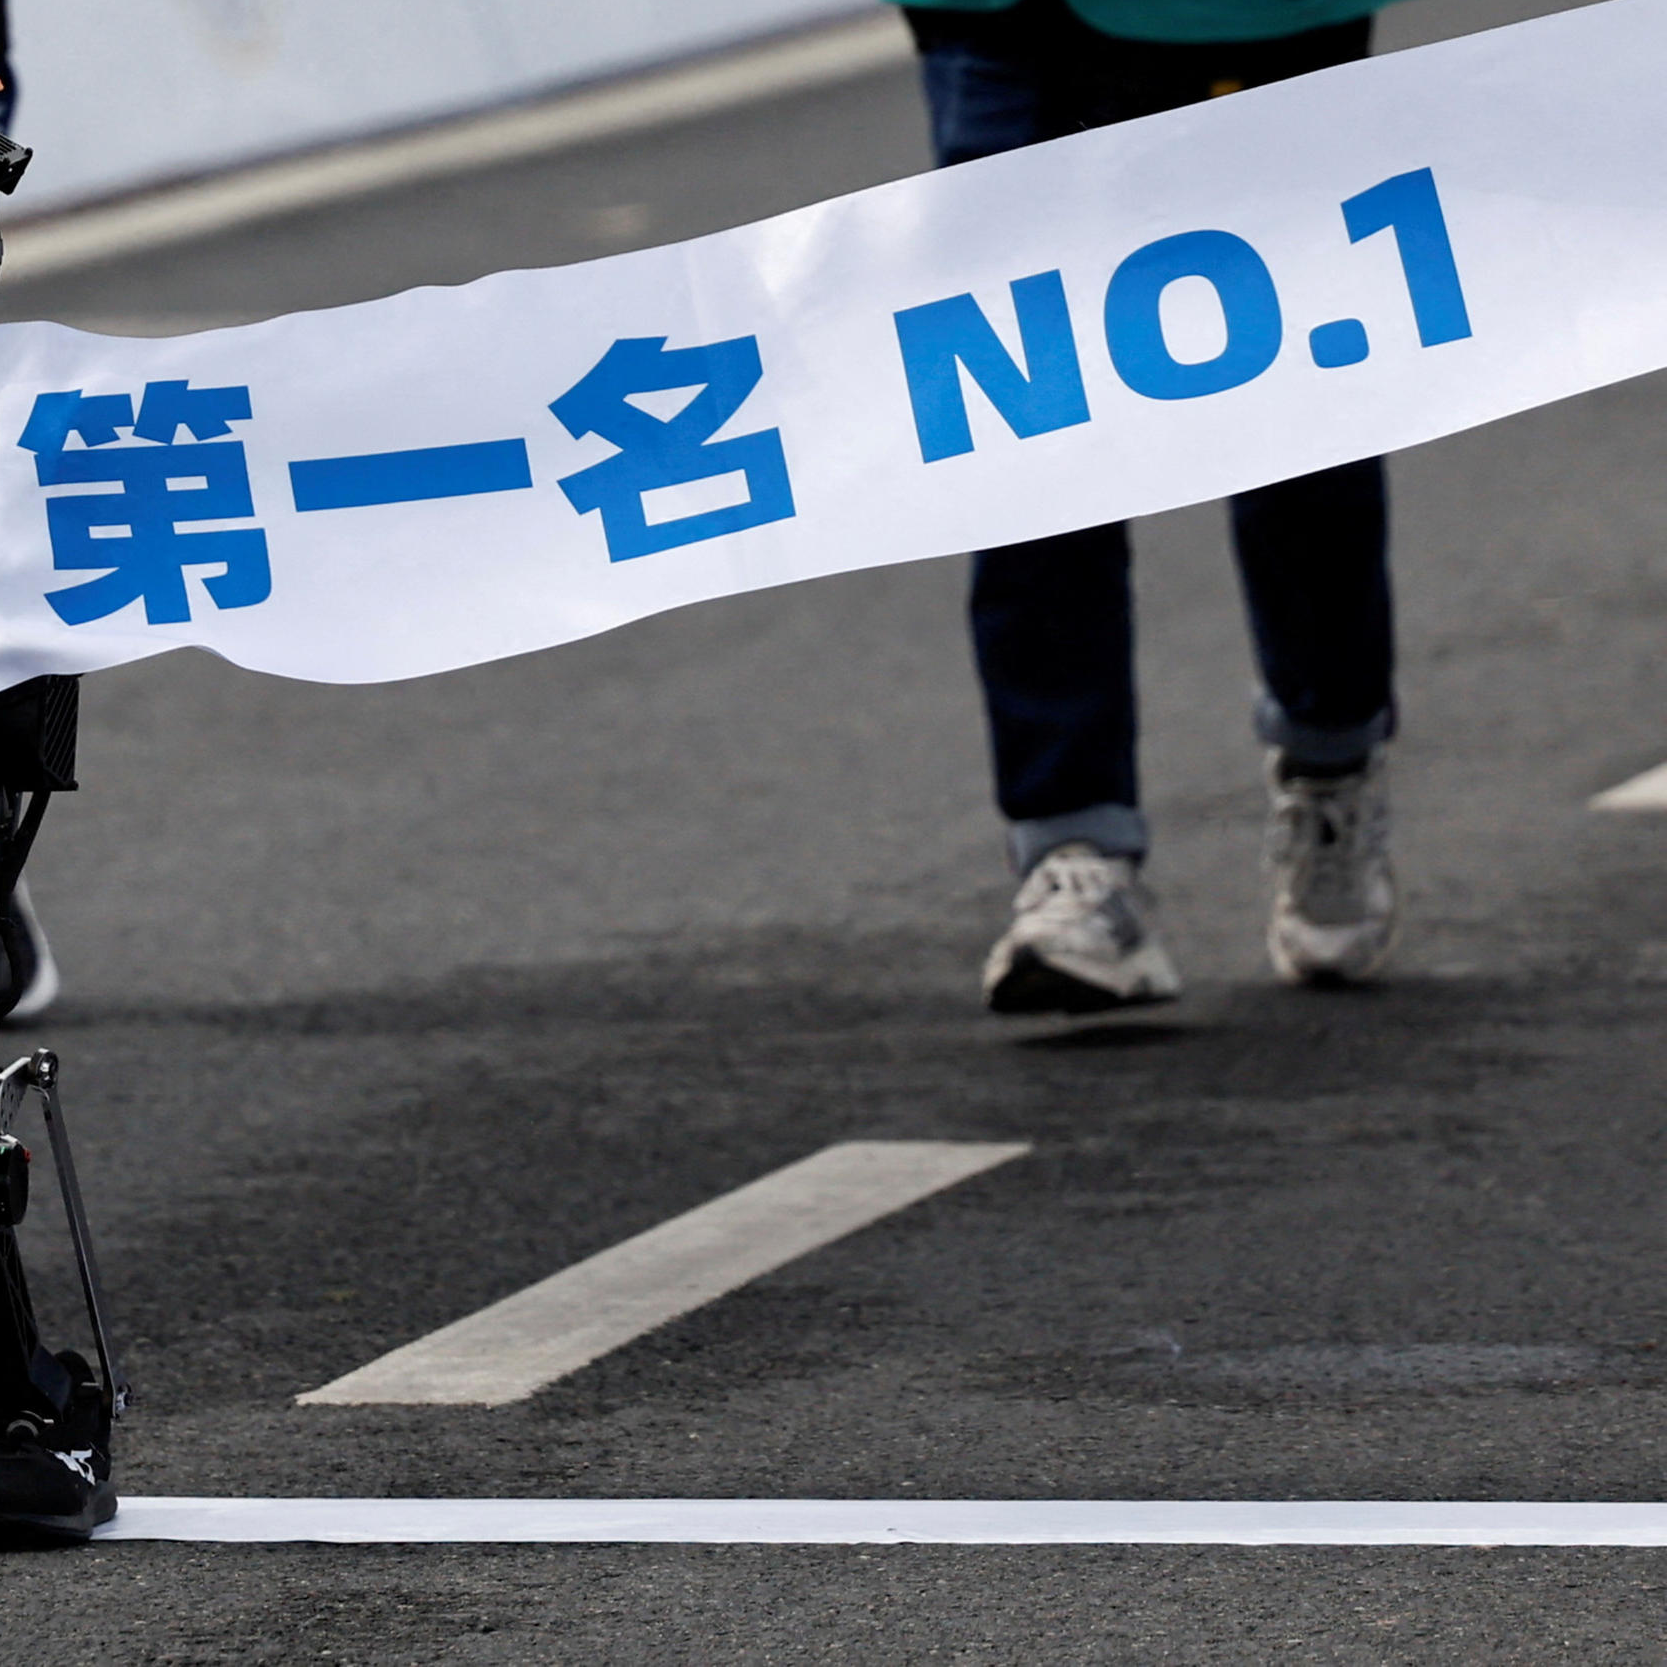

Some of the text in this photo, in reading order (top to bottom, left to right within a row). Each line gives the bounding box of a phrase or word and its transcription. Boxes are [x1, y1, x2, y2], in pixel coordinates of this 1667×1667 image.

[892, 166, 1474, 463] NO.1
[17, 334, 797, 627] 第一名
